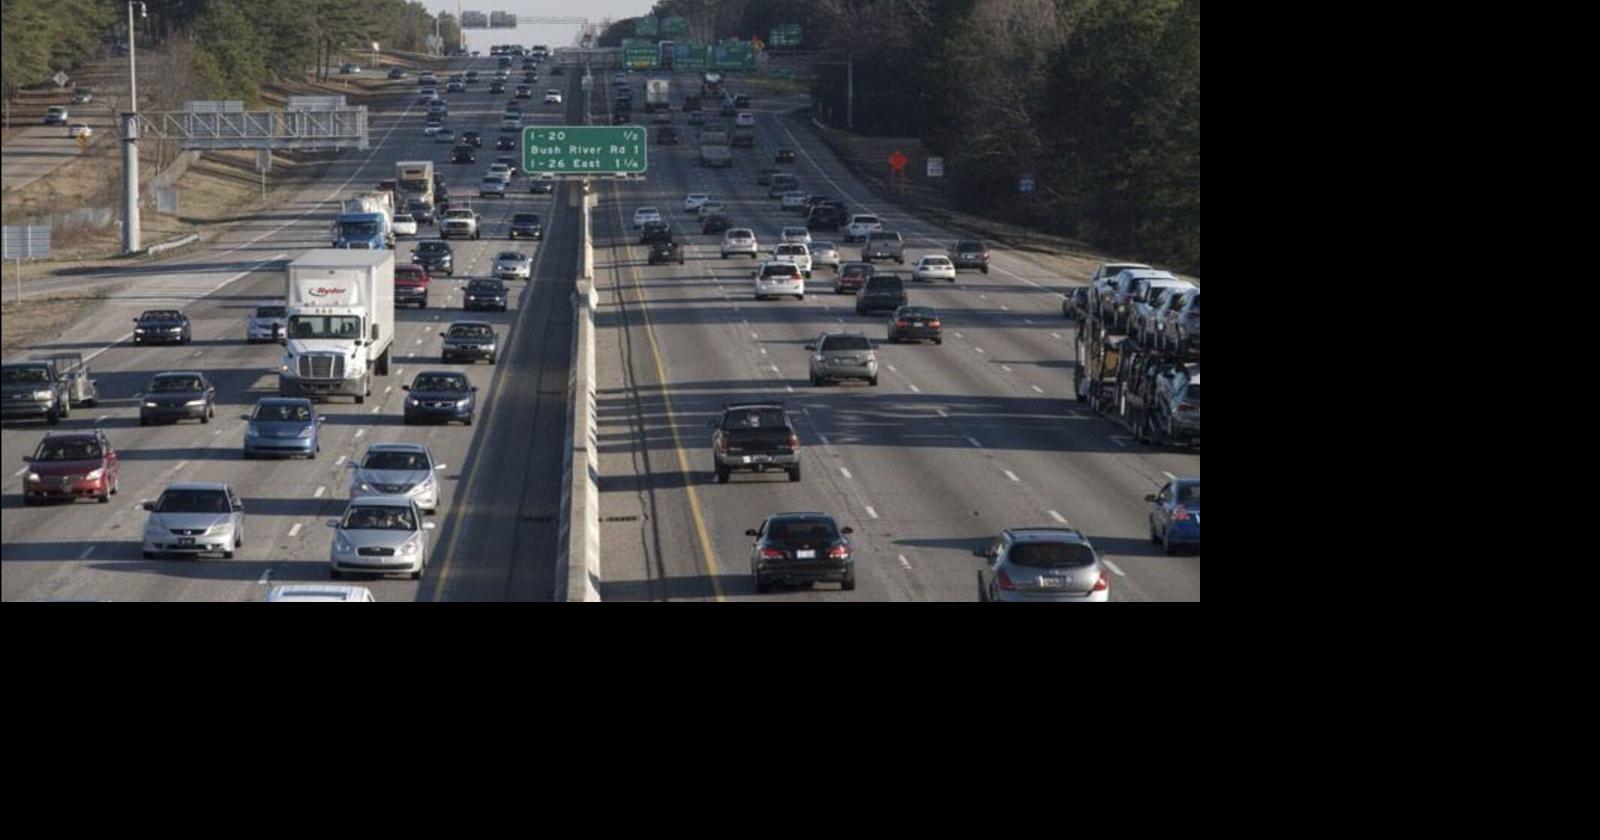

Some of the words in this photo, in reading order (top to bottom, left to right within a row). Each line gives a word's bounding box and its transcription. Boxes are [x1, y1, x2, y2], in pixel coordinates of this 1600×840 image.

[530, 145, 562, 154] Bush
[569, 145, 602, 154] River
[610, 145, 625, 154] Rd
[634, 145, 638, 154] 1
[573, 159, 601, 168] East
[316, 287, 347, 295] Ryder
